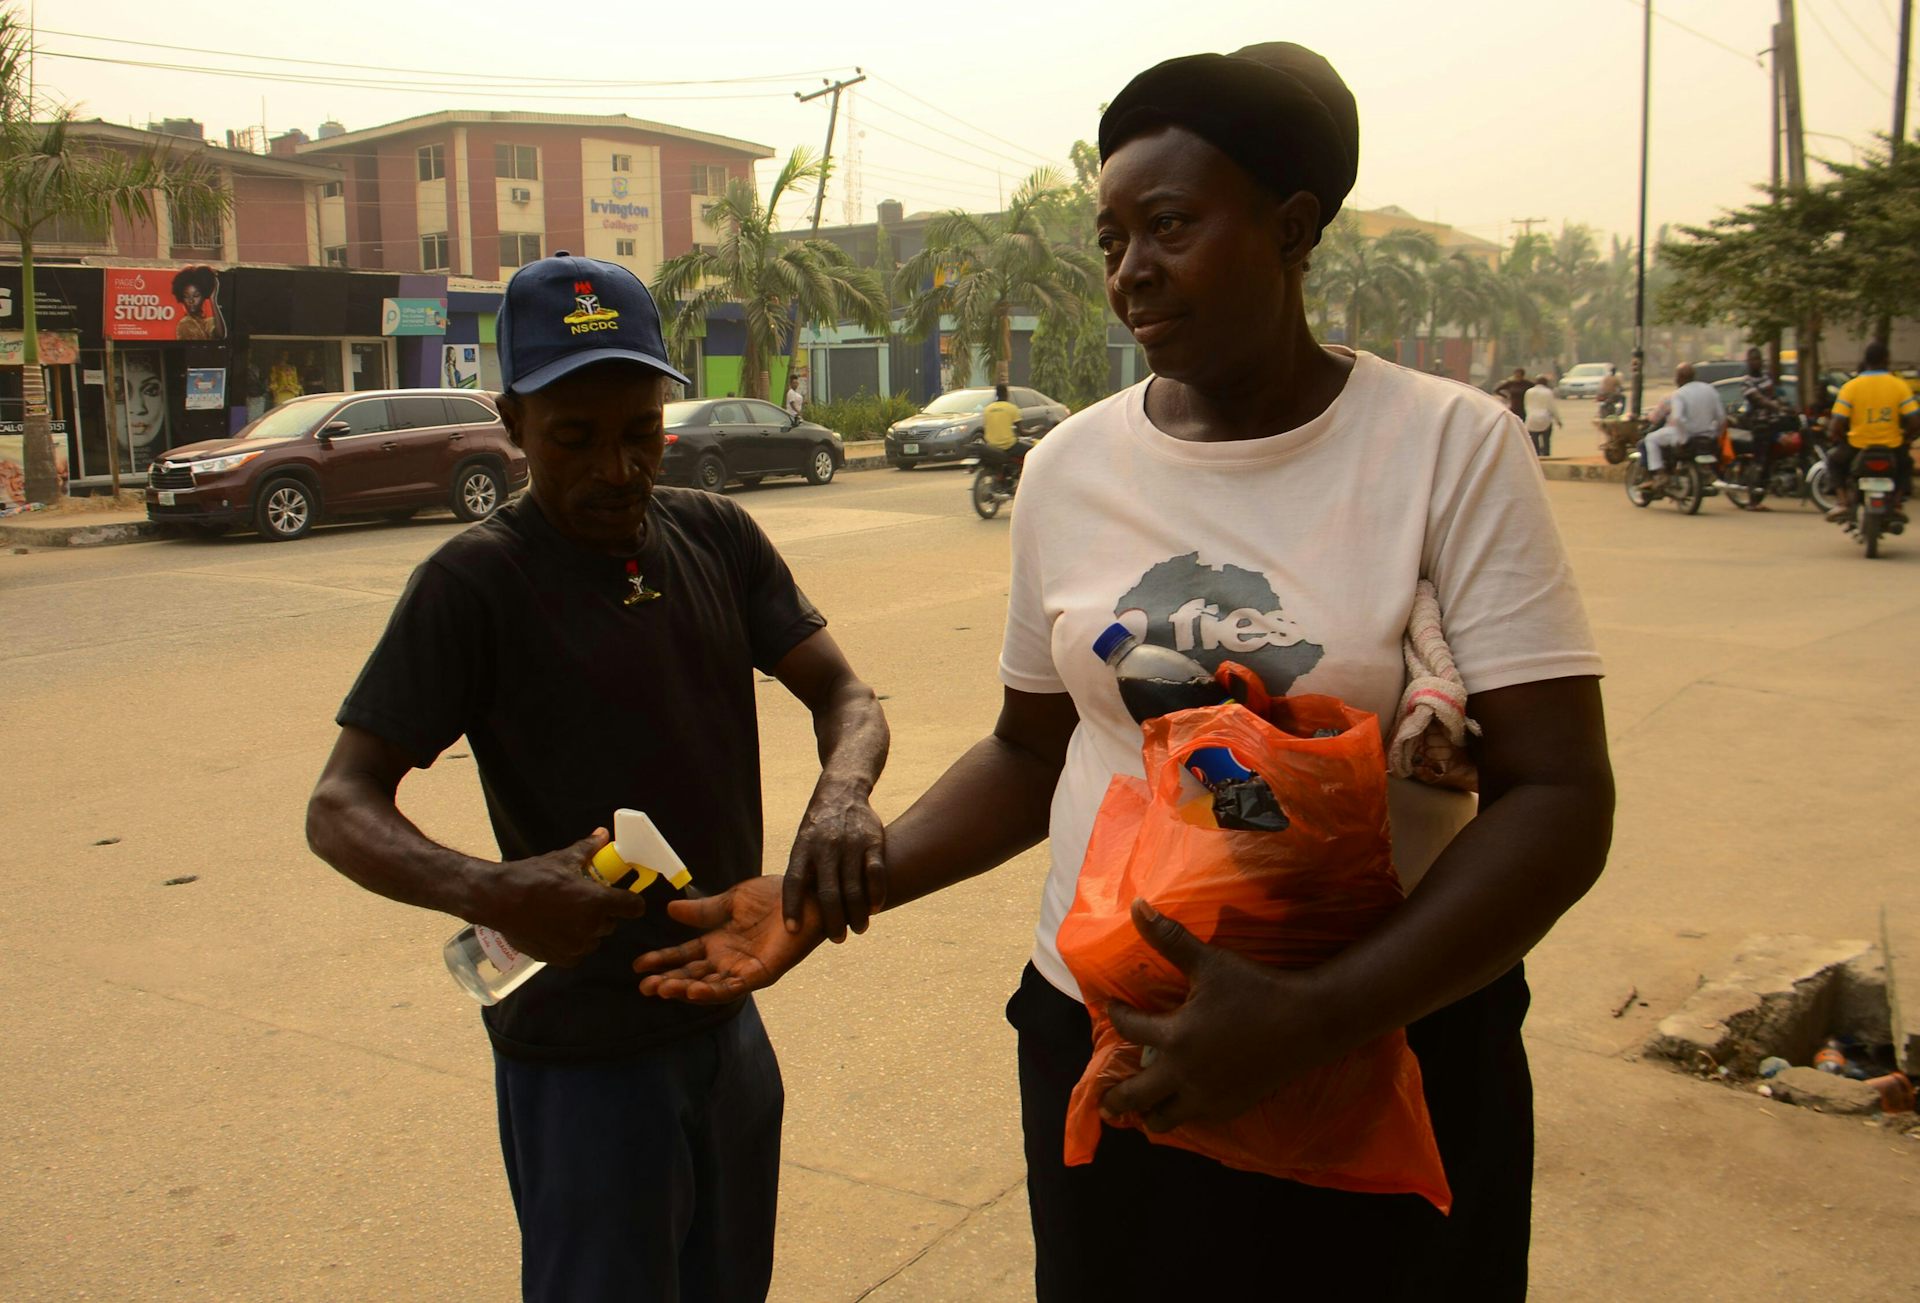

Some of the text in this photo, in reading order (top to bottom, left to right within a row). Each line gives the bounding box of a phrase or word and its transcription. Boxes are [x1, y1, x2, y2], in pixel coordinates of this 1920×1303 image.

[591, 199, 649, 219] Irvington
[117, 294, 160, 306] PHOTO
[114, 305, 176, 321] STUDIO
[571, 321, 619, 335] NSCDC
